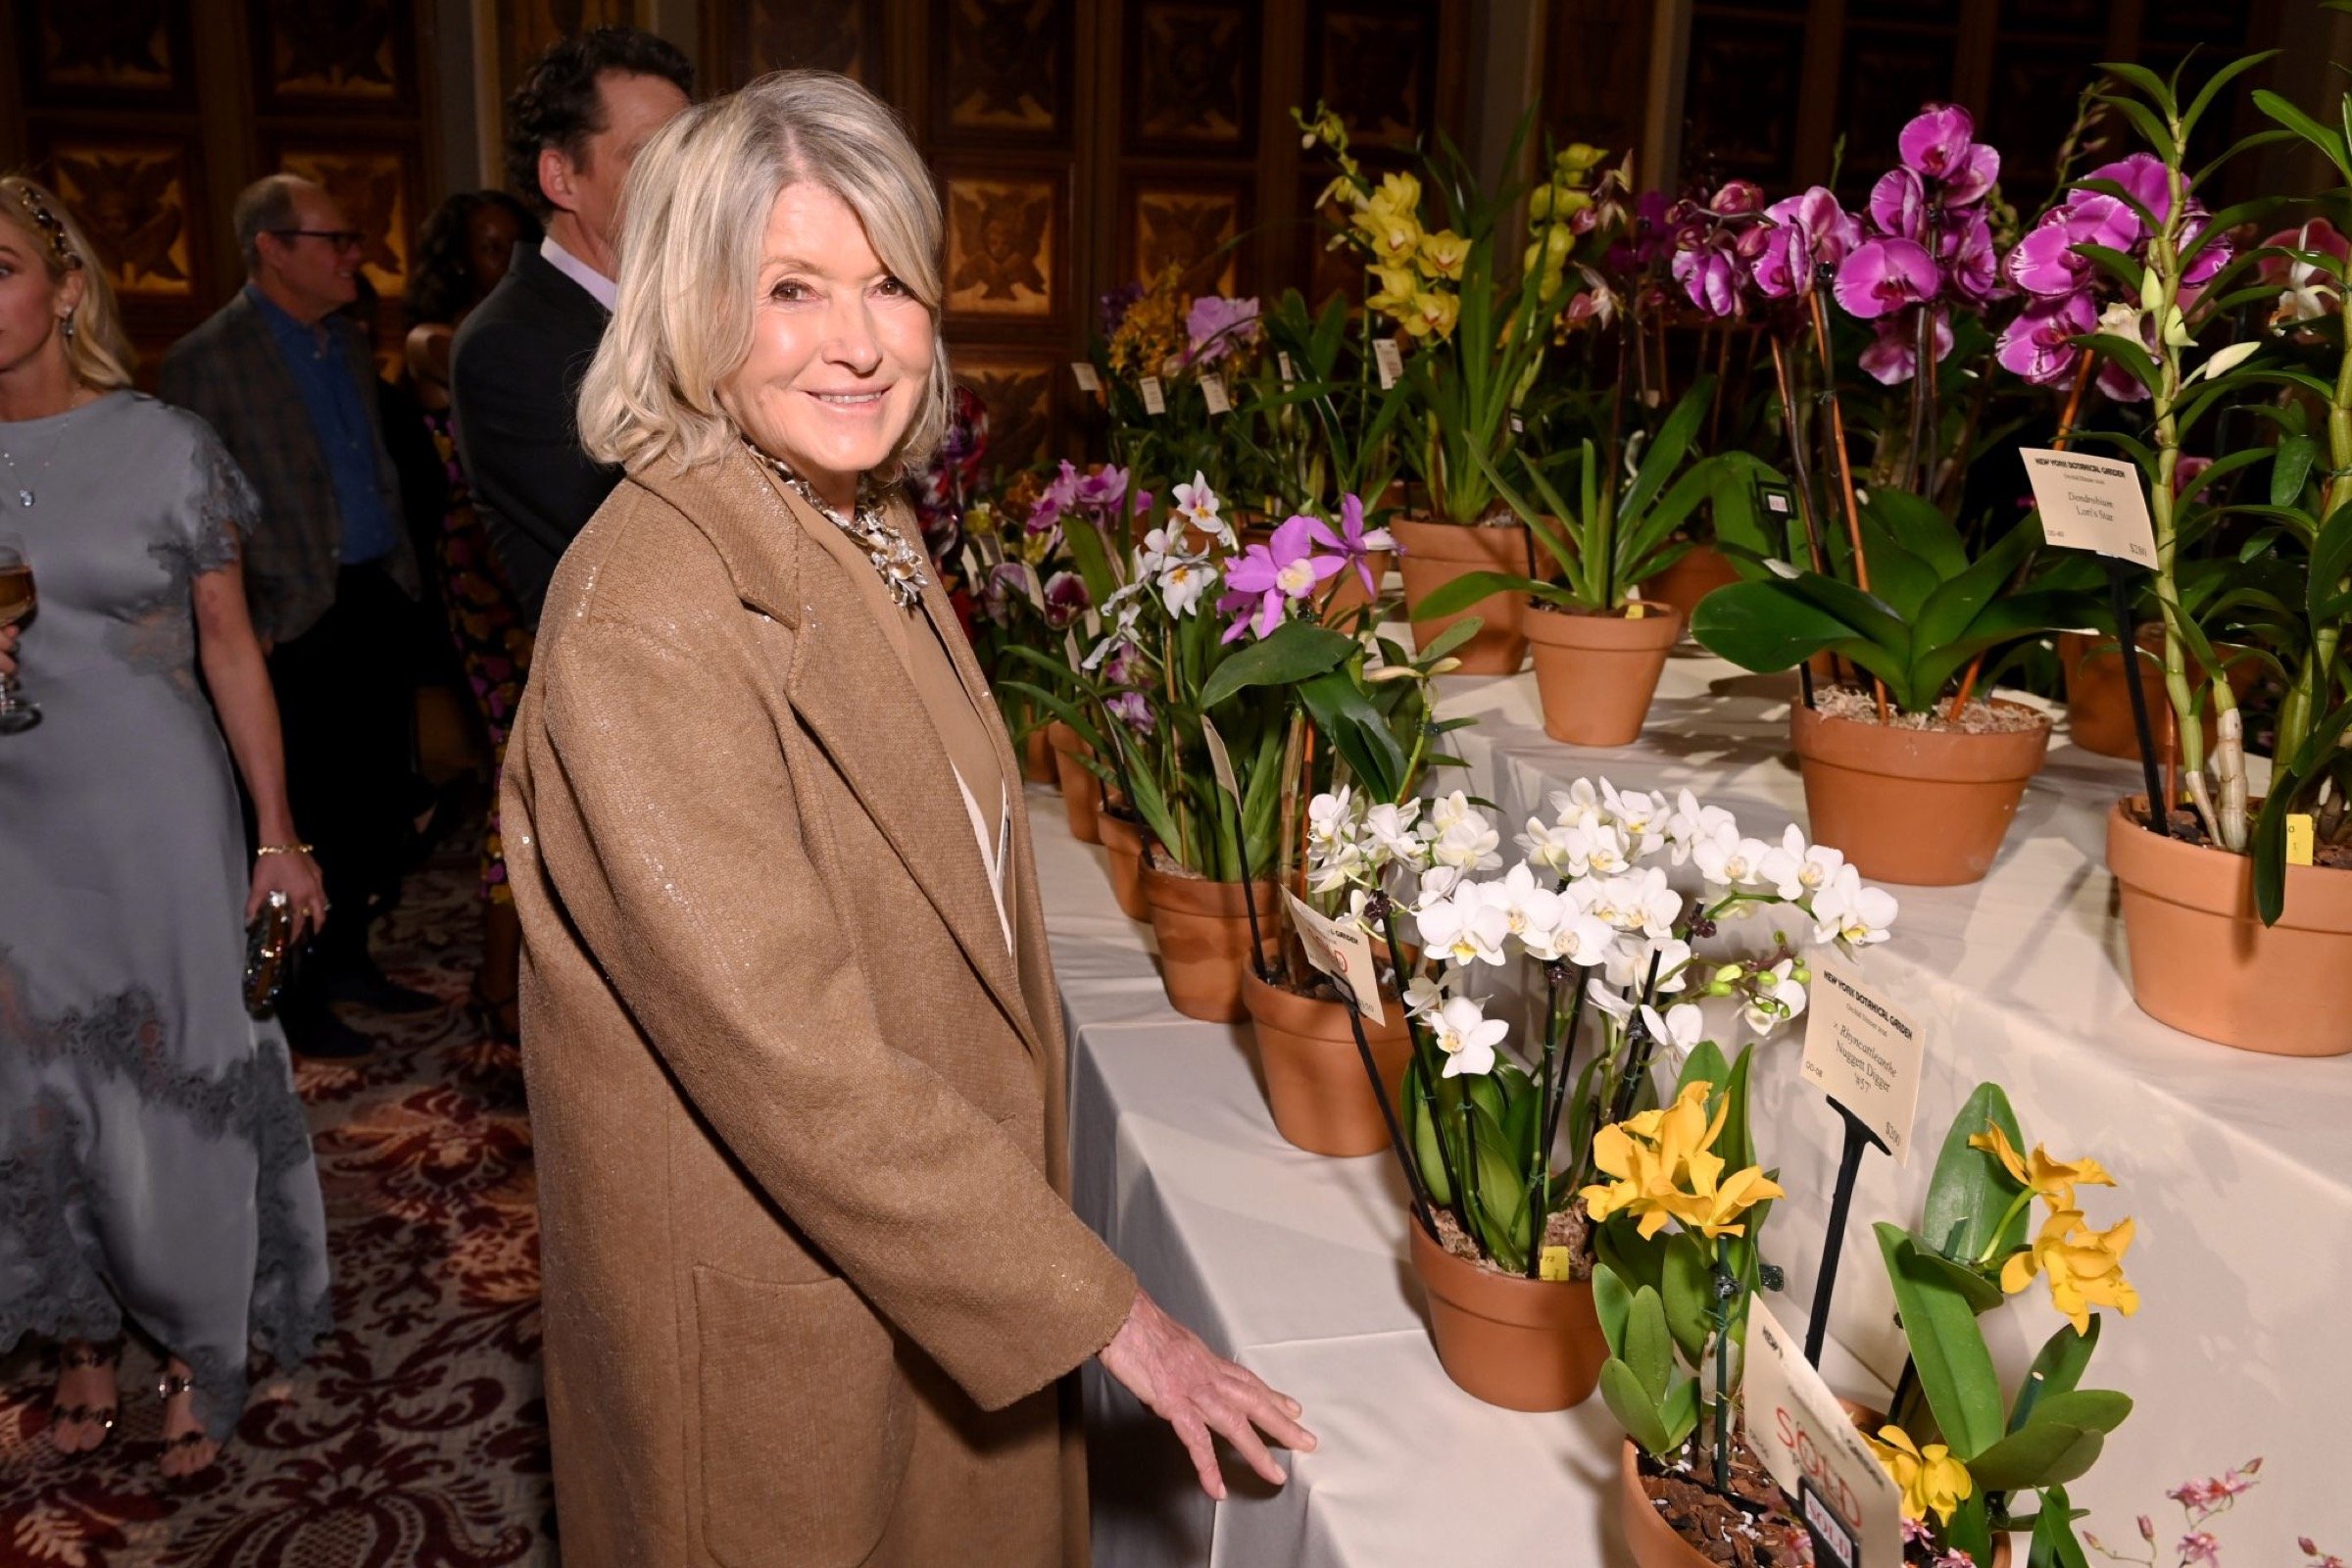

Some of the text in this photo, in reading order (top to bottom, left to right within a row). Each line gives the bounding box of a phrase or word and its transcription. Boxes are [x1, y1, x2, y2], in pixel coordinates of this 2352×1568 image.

[2050, 460, 2067, 468] YORK
[2068, 462, 2100, 472] BOTANICAL
[2101, 467, 2126, 478] GARDEN
[1824, 970, 1913, 1041] NEW YORK BOTANICAL GARDEN
[1776, 1407, 1862, 1528] SOLD
